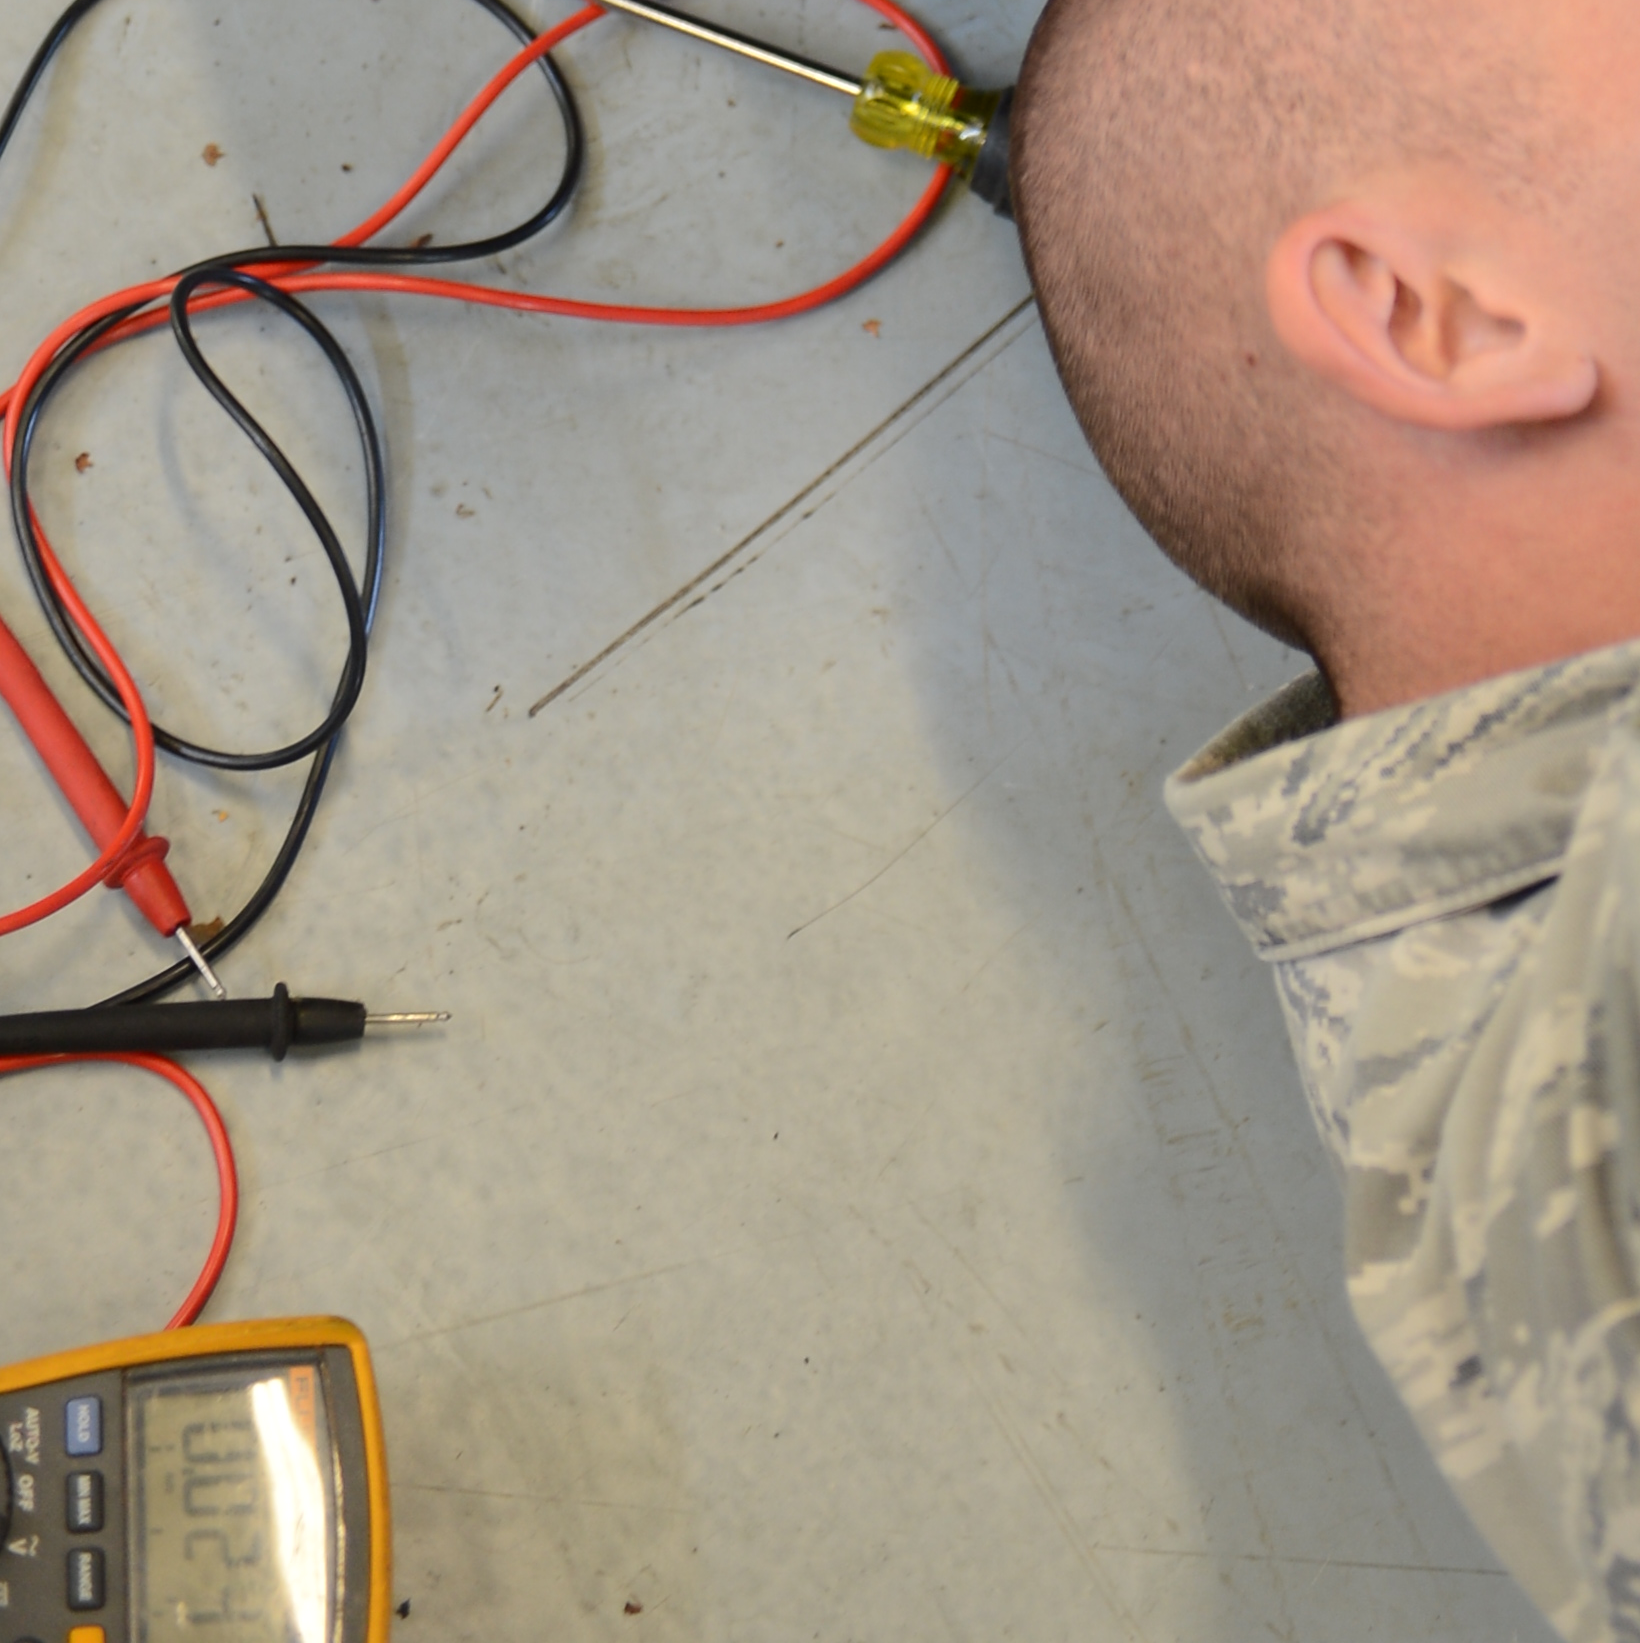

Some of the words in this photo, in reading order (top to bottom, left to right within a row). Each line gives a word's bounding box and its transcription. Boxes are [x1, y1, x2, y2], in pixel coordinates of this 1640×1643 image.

[24, 1406, 39, 1464] AUTO-V
[77, 1403, 90, 1441] HOLD
[17, 1473, 33, 1512] OFF
[77, 1474, 90, 1497] MIN
[77, 1498, 90, 1525] MAX
[78, 1551, 91, 1601] RANGE
